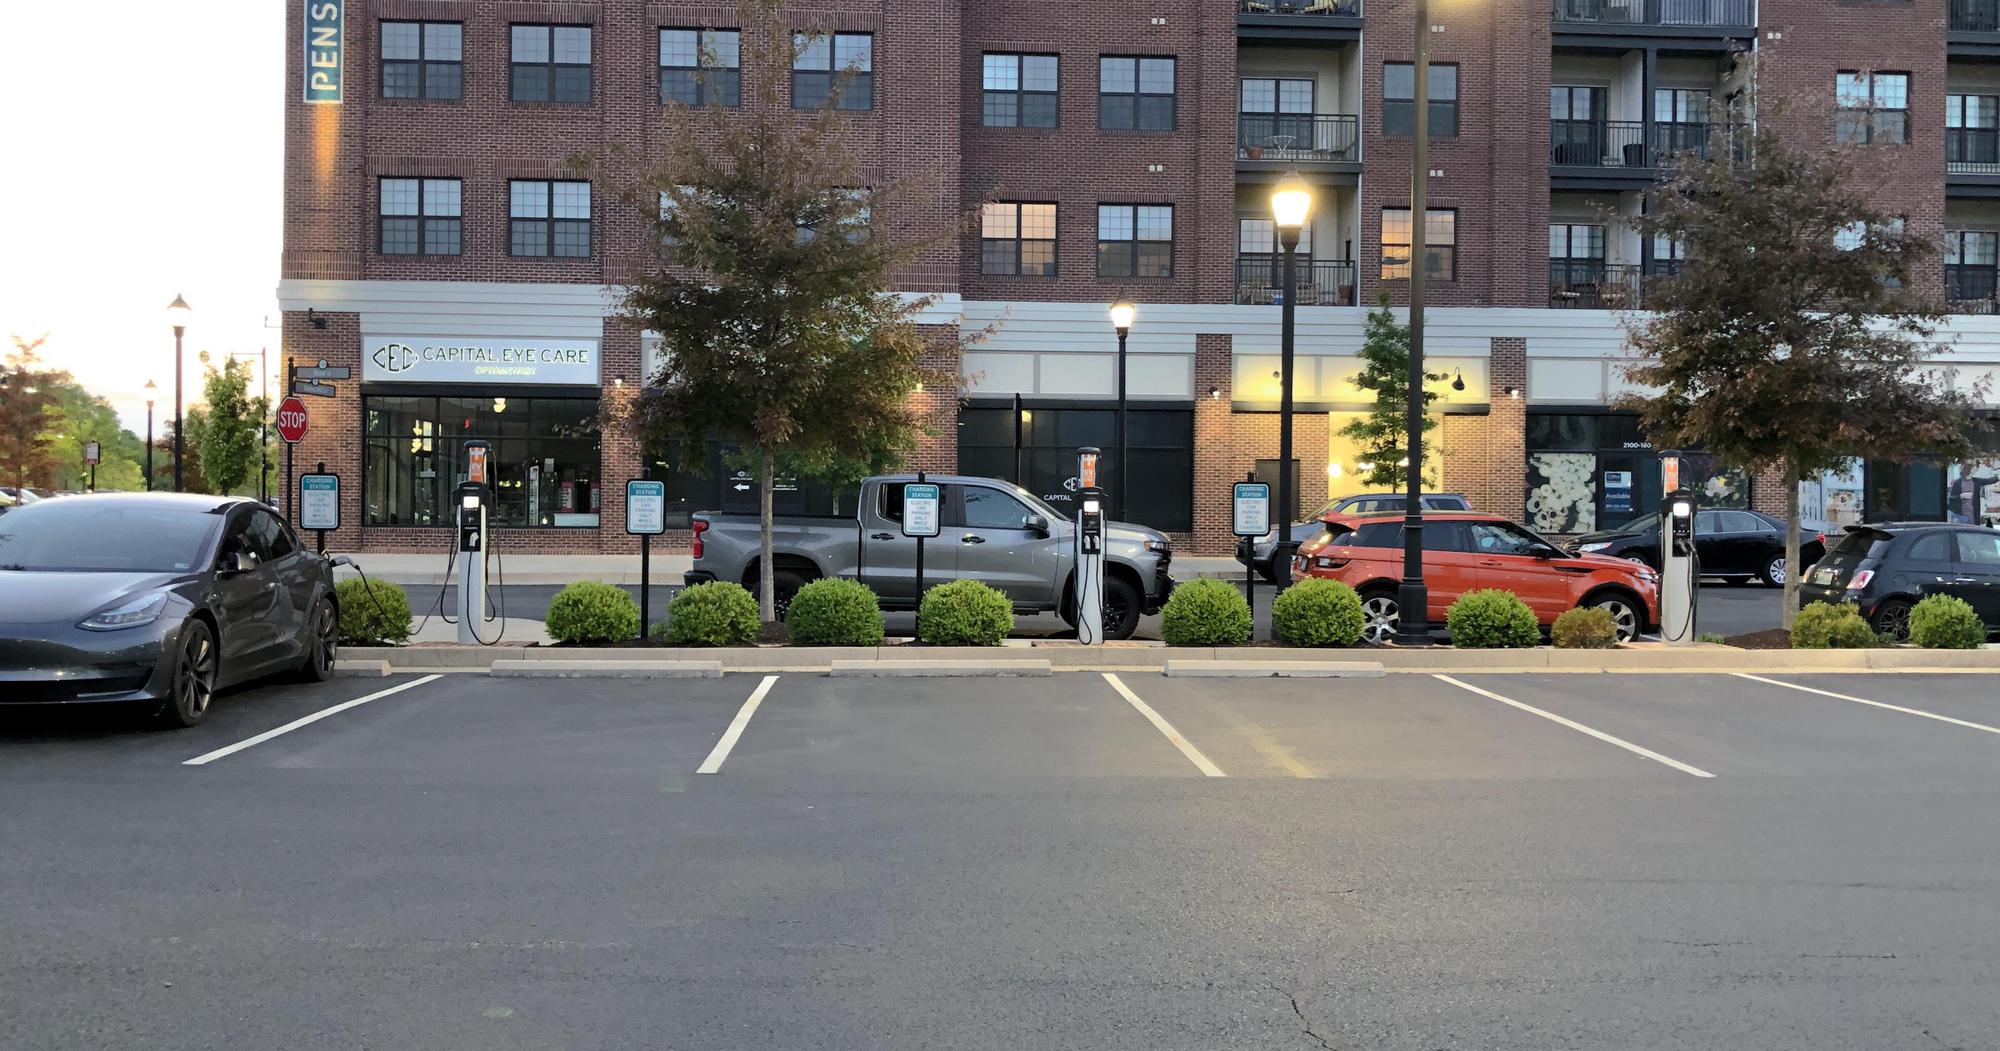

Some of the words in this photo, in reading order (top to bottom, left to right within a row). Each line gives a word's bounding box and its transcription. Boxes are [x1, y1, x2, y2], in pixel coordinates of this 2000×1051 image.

[422, 346, 498, 362] CAPITAL
[503, 348, 536, 363] EYE
[540, 349, 590, 364] CARE
[280, 411, 305, 428] STOP
